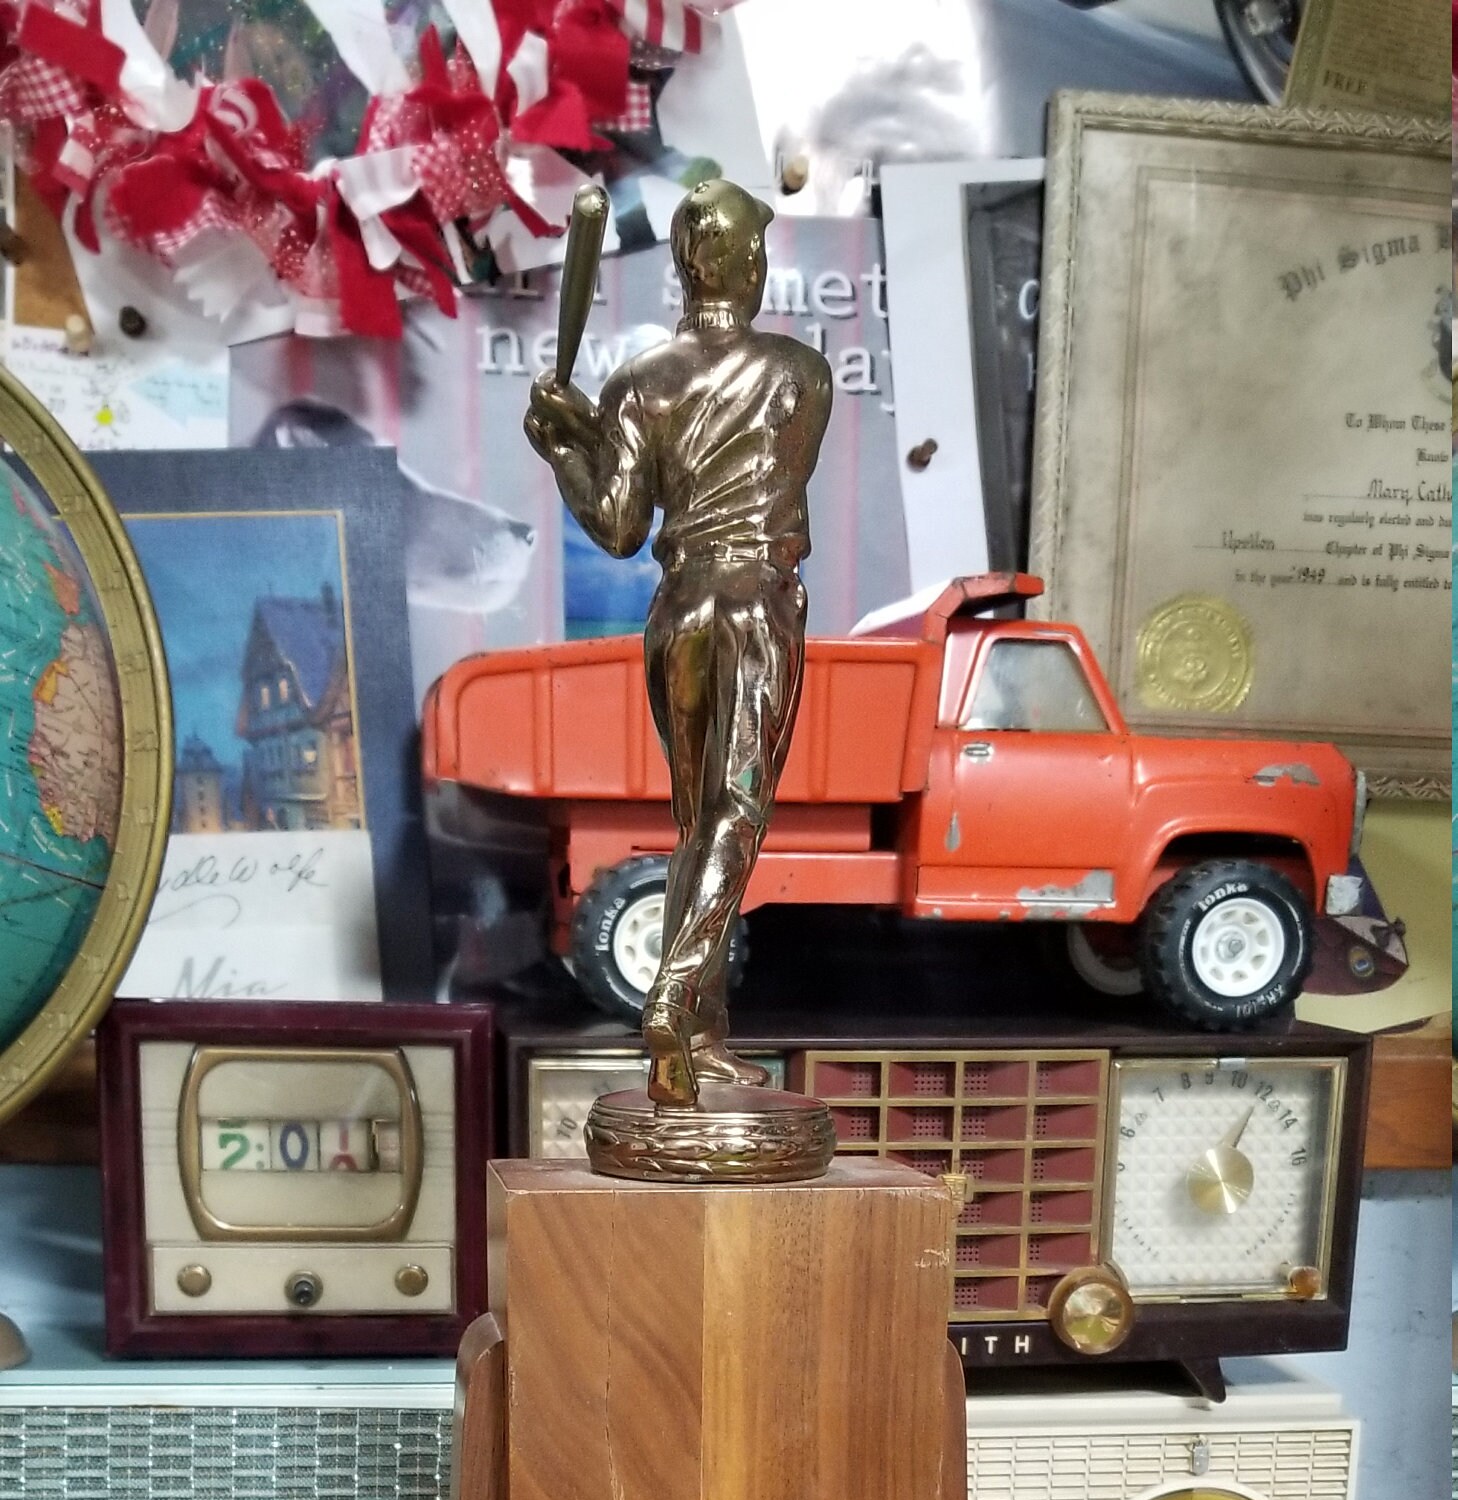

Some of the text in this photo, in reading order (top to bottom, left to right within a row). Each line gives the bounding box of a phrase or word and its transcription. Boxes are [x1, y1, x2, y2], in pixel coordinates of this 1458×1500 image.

[1367, 479, 1412, 506] Mary
[1231, 1070, 1248, 1089] 10
[1253, 1080, 1274, 1102] 12
[1278, 1108, 1299, 1132] 14
[1291, 1147, 1308, 1167] 16
